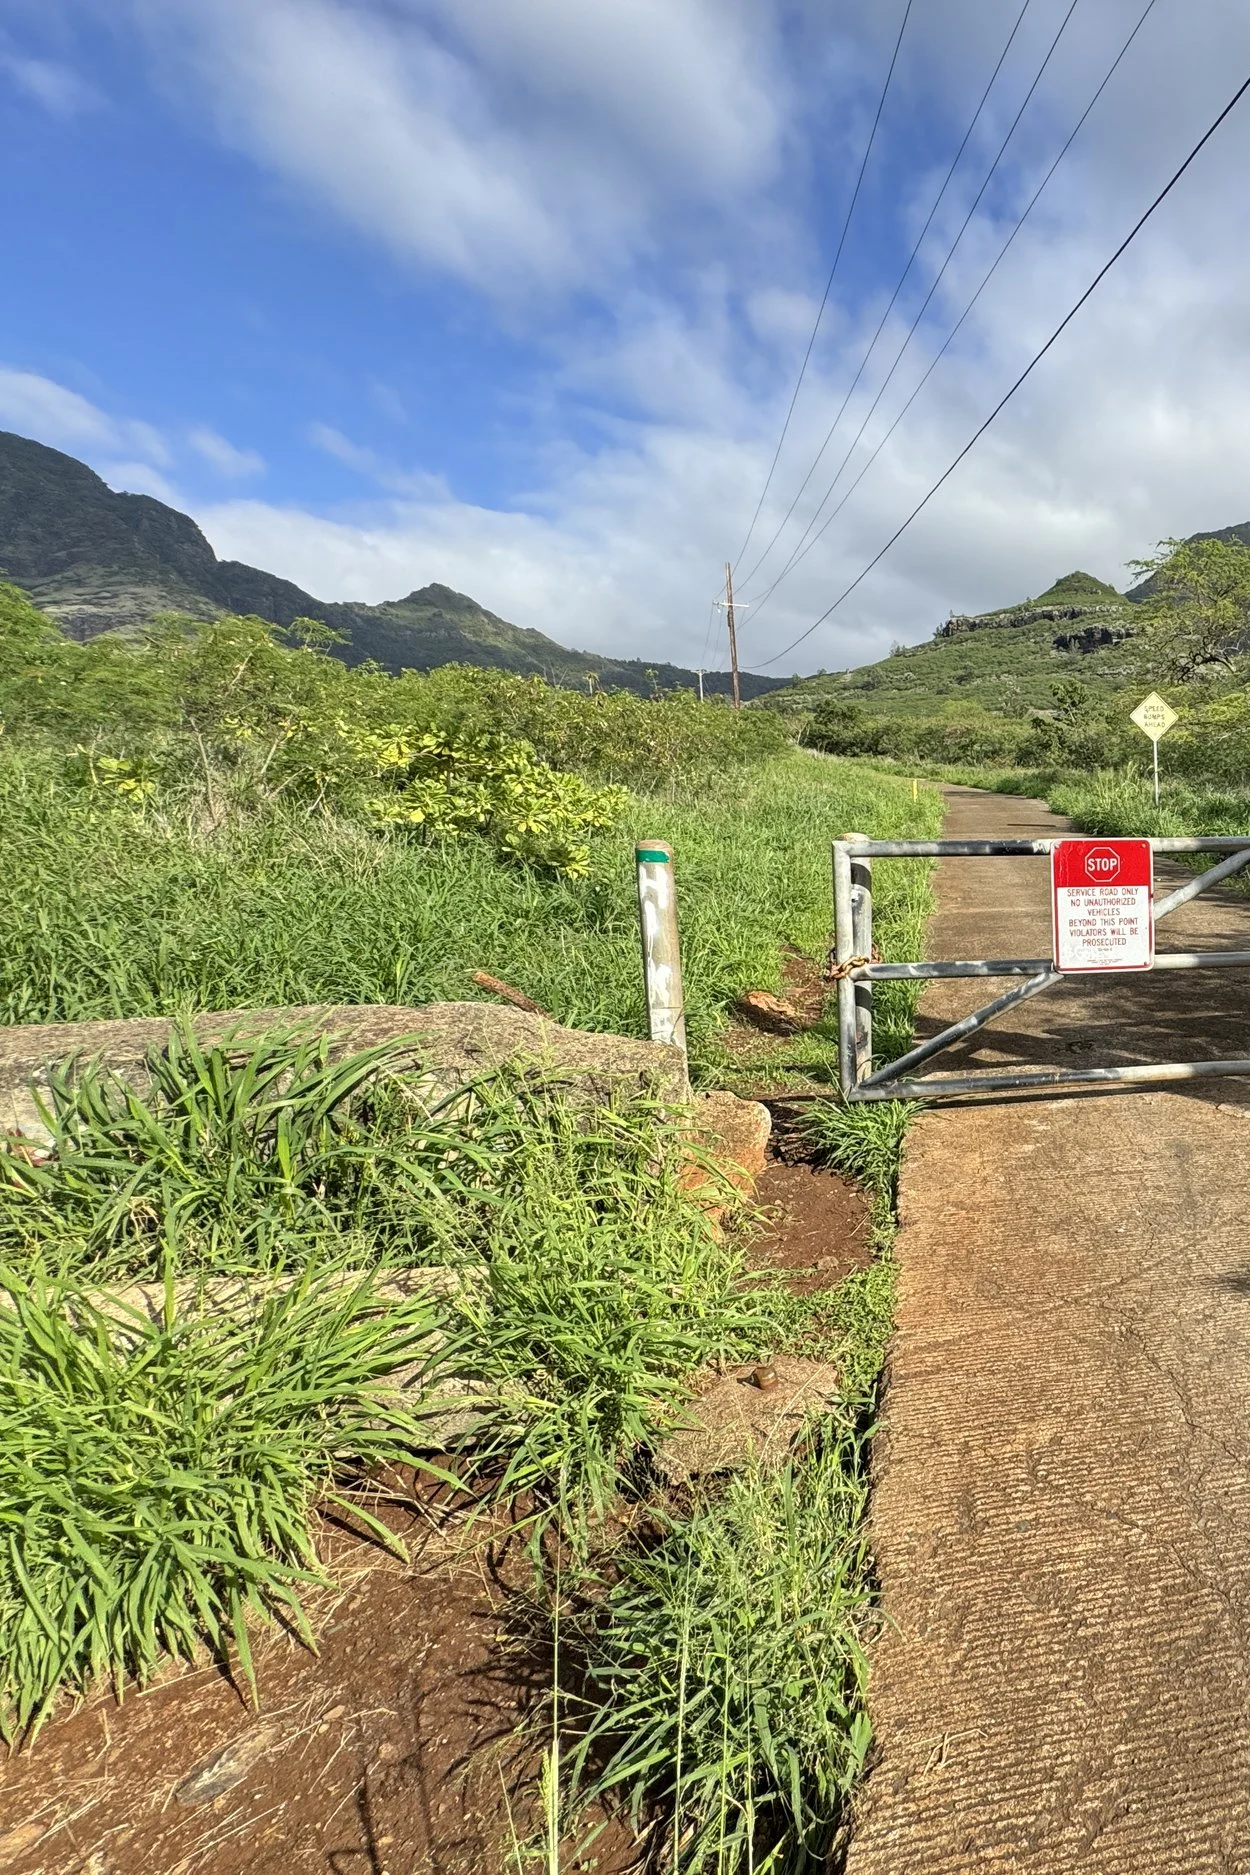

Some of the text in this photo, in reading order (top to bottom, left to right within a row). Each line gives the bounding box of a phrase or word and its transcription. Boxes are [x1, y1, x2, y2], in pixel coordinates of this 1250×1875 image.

[1087, 858, 1118, 871] STOP
[1066, 888, 1139, 897] SERVICE ROAD ONLY
[1070, 898, 1136, 907] NO UNAUTHORIZED
[1087, 908, 1120, 916] VEHICLES
[1068, 917, 1139, 927] BEYOND THIS POINT
[1069, 927, 1139, 936] VIOLATORS WILL BE
[1082, 938, 1127, 947] PROSECUTED
